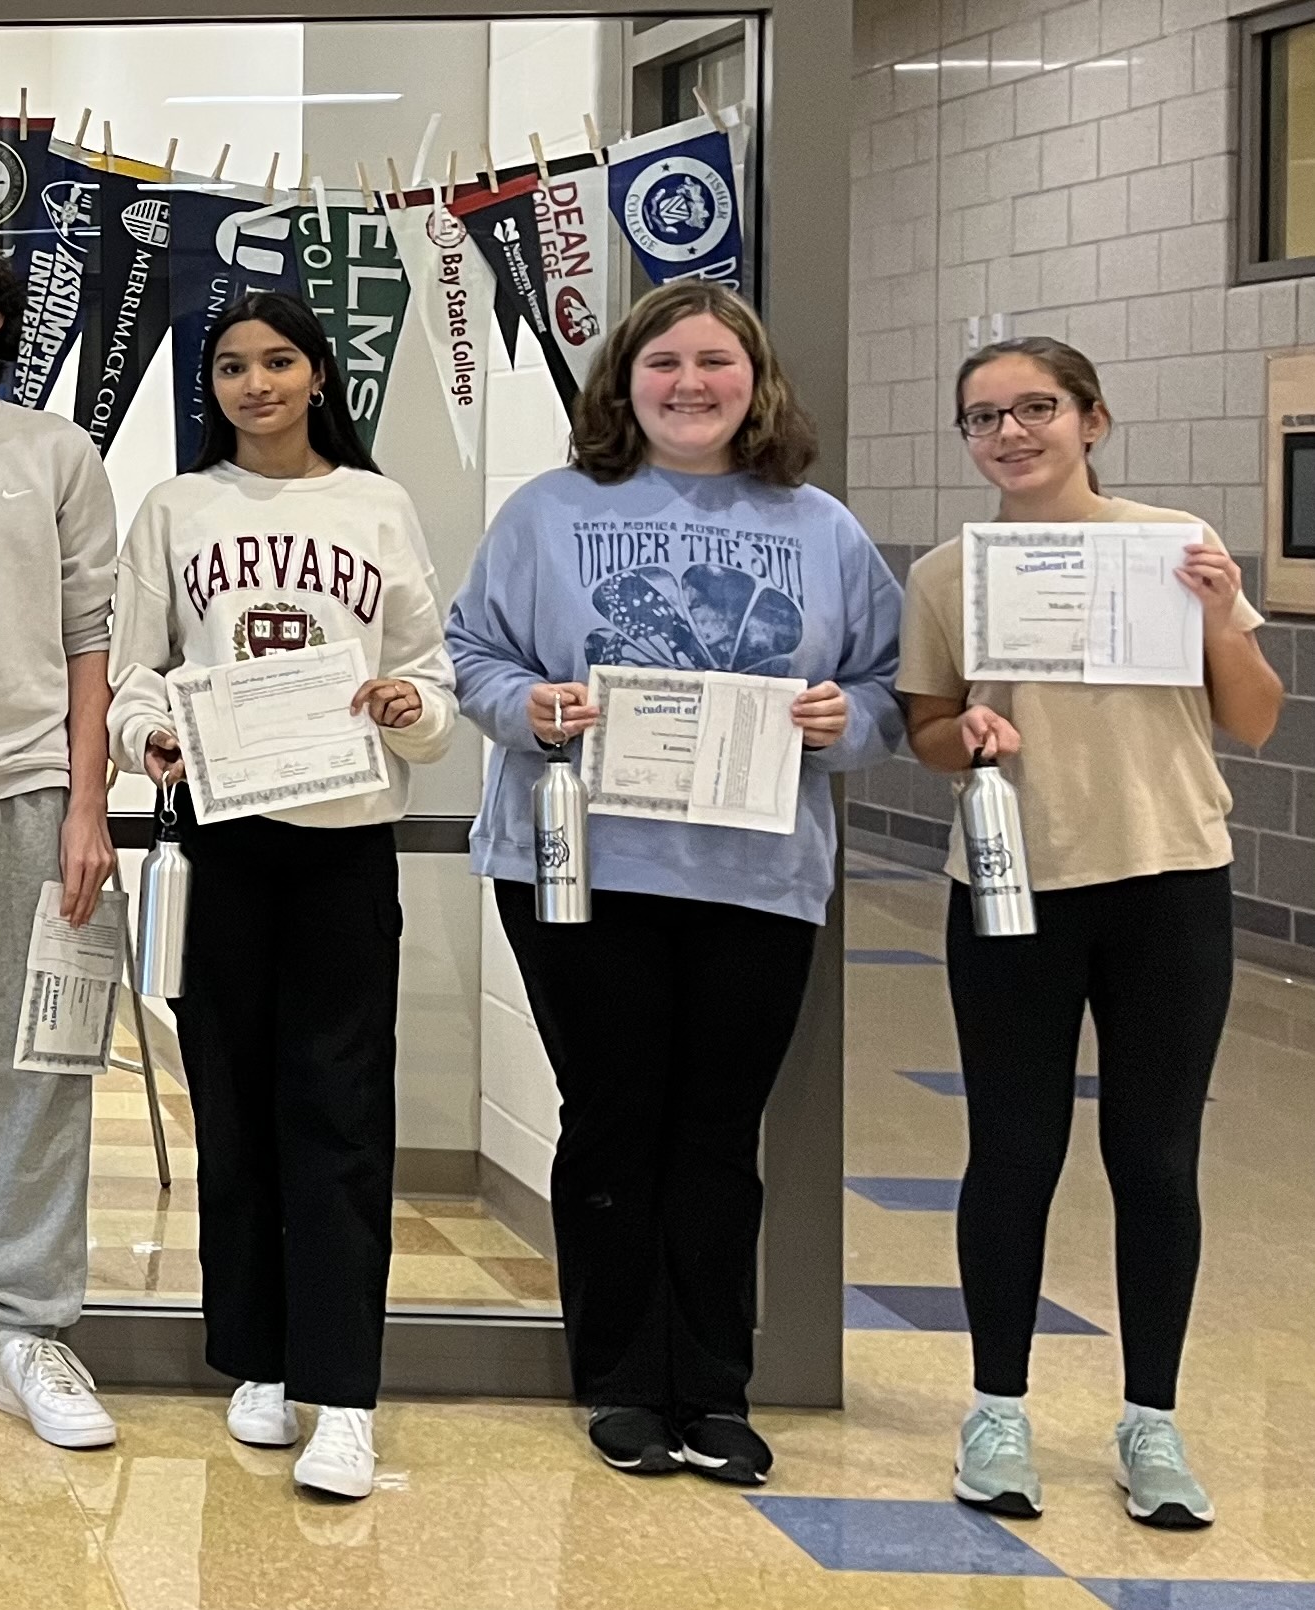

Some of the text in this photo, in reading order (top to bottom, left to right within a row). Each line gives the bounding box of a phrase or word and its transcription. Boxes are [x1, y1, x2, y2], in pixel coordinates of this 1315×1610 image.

[532, 189, 563, 280] COLLEGE
[548, 181, 594, 278] DEAN
[627, 193, 659, 253] COLLEGE
[704, 171, 730, 220] FISHER
[12, 249, 54, 402] UNIVERSITY
[102, 248, 153, 384] MERRIMACK
[345, 211, 404, 422] ELMS
[440, 252, 476, 406] Bay State College
[572, 521, 803, 549] SANTA MONICA MUSIC FESTIVAL
[573, 532, 806, 612] UNDER THE SUN
[1015, 561, 1067, 575] Student
[183, 534, 383, 626] HARVARD
[633, 704, 698, 717] Student of
[49, 989, 60, 1031] Student
